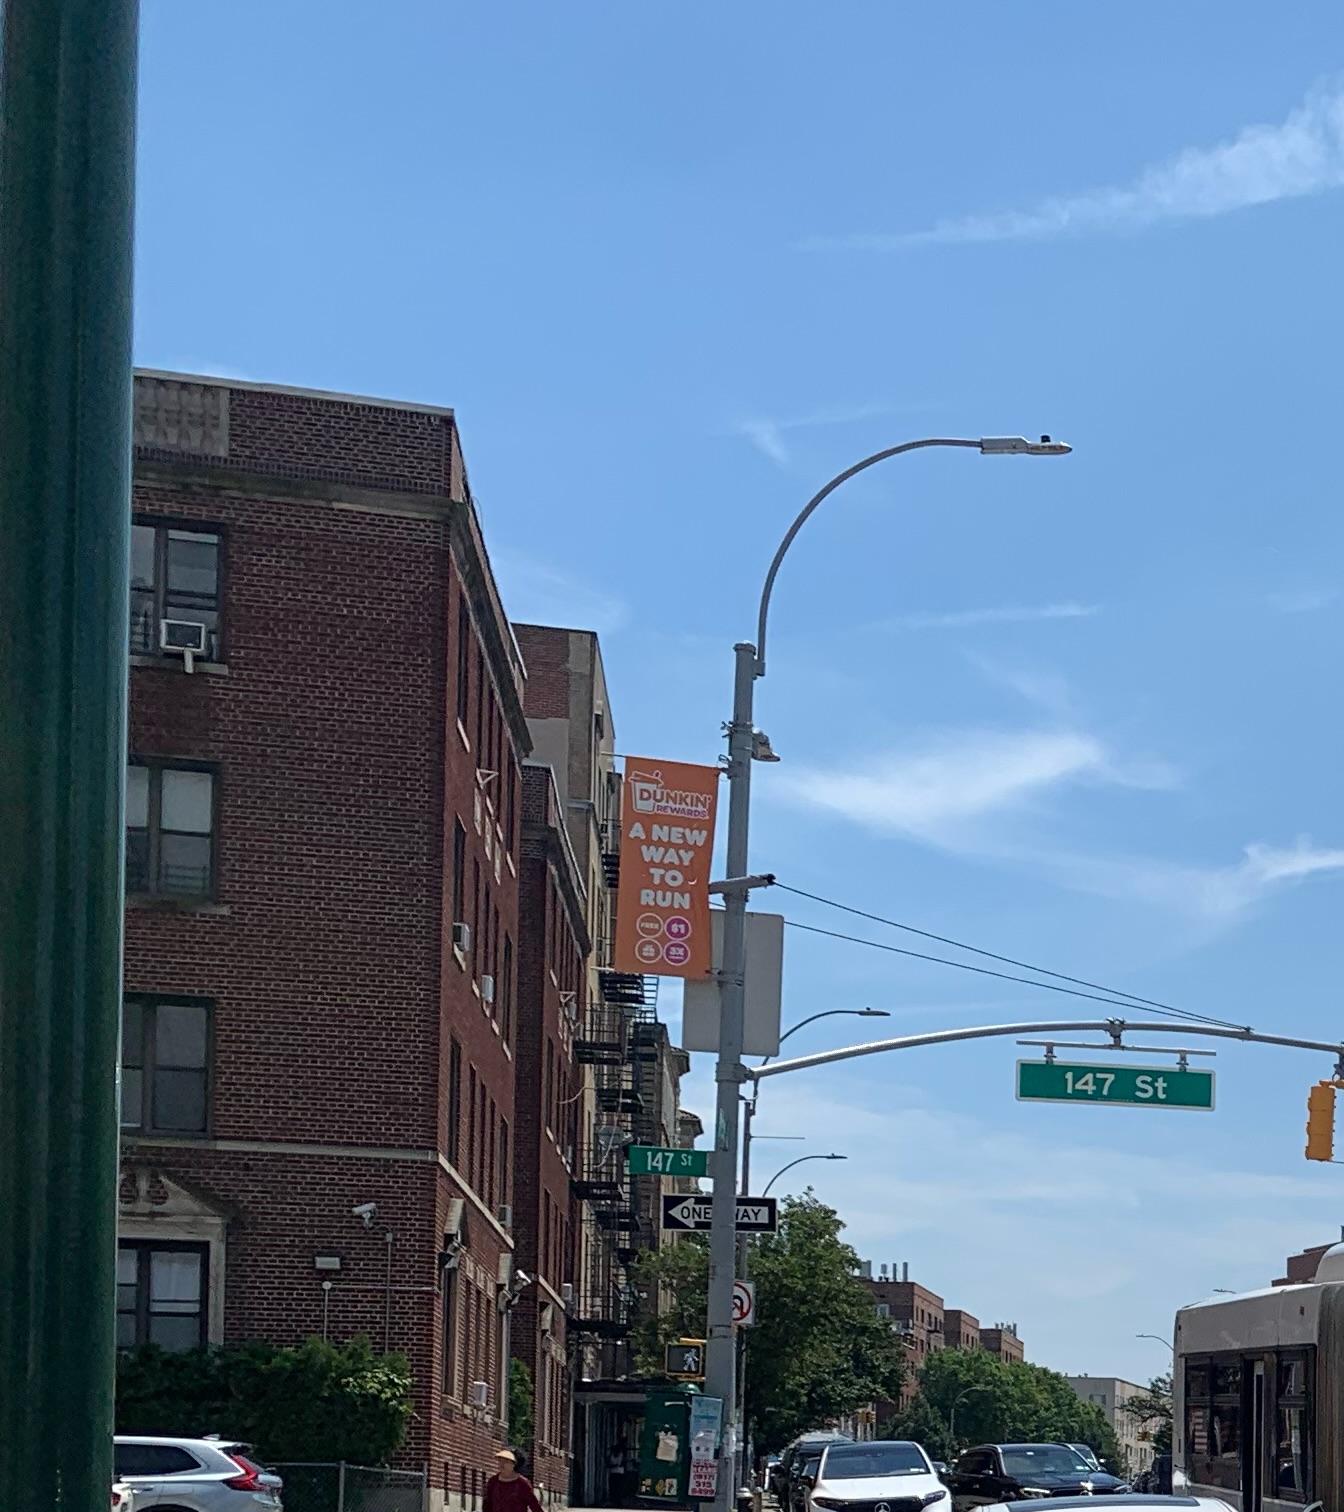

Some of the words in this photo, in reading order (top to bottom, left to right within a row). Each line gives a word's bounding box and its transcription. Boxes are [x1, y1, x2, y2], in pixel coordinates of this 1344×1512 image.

[640, 788, 712, 809] DUNKIN'
[656, 804, 707, 818] REWARDS
[629, 822, 646, 840] A
[651, 824, 708, 847] NEW
[641, 845, 694, 866] WAY
[649, 868, 684, 887] TO
[640, 889, 690, 909] RUN
[1065, 1071, 1115, 1095] 147
[1135, 1075, 1167, 1099] St
[646, 1152, 672, 1171] 147
[681, 1154, 693, 1167] St
[680, 1206, 711, 1220] ONE
